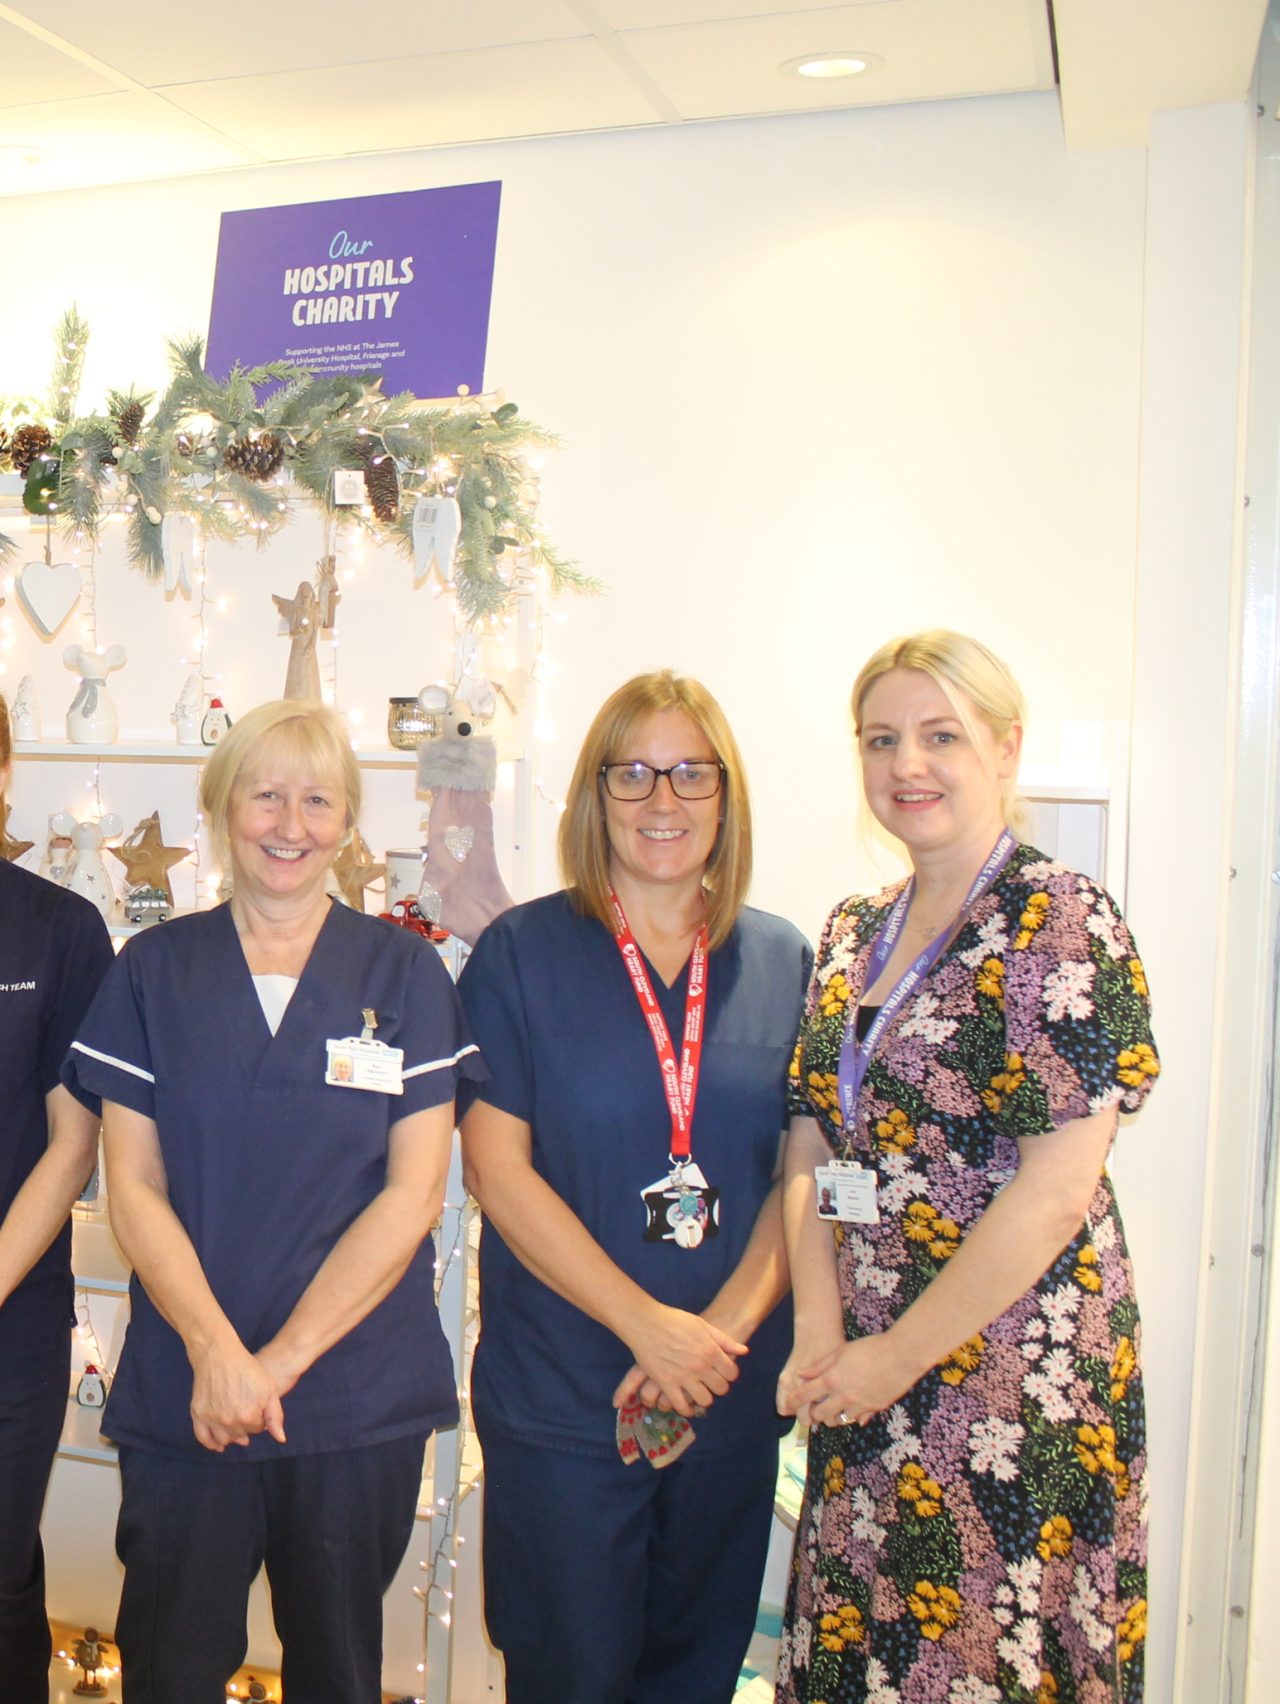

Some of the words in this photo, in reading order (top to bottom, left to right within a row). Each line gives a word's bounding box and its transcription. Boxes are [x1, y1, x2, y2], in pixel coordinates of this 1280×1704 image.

[328, 230, 373, 259] Our
[283, 256, 414, 295] HOSPITALS
[292, 291, 399, 327] CHARITY
[285, 346, 322, 356] Supporting
[323, 345, 336, 353] the
[336, 344, 352, 352] NHS
[362, 342, 375, 350] The
[376, 341, 399, 349] James
[296, 355, 330, 365] University
[330, 353, 361, 362] Hospital,
[362, 350, 390, 360] Friarage
[391, 350, 405, 358] and
[350, 361, 382, 371] hospitals
[876, 945, 888, 960] Our
[882, 903, 907, 944] HOSPITALS
[633, 956, 643, 976] SOUTH
[690, 964, 698, 983] SOUTH
[10, 981, 36, 992] TEAM
[881, 970, 919, 1015] HOSPITALS
[862, 1016, 886, 1056] CHARITY
[682, 1048, 690, 1082] CLEVELAND
[666, 1073, 674, 1095] HEART
[671, 1073, 680, 1095] SOUTH
[683, 1084, 692, 1105] HEART
[675, 1096, 685, 1131] CLEVELAND
